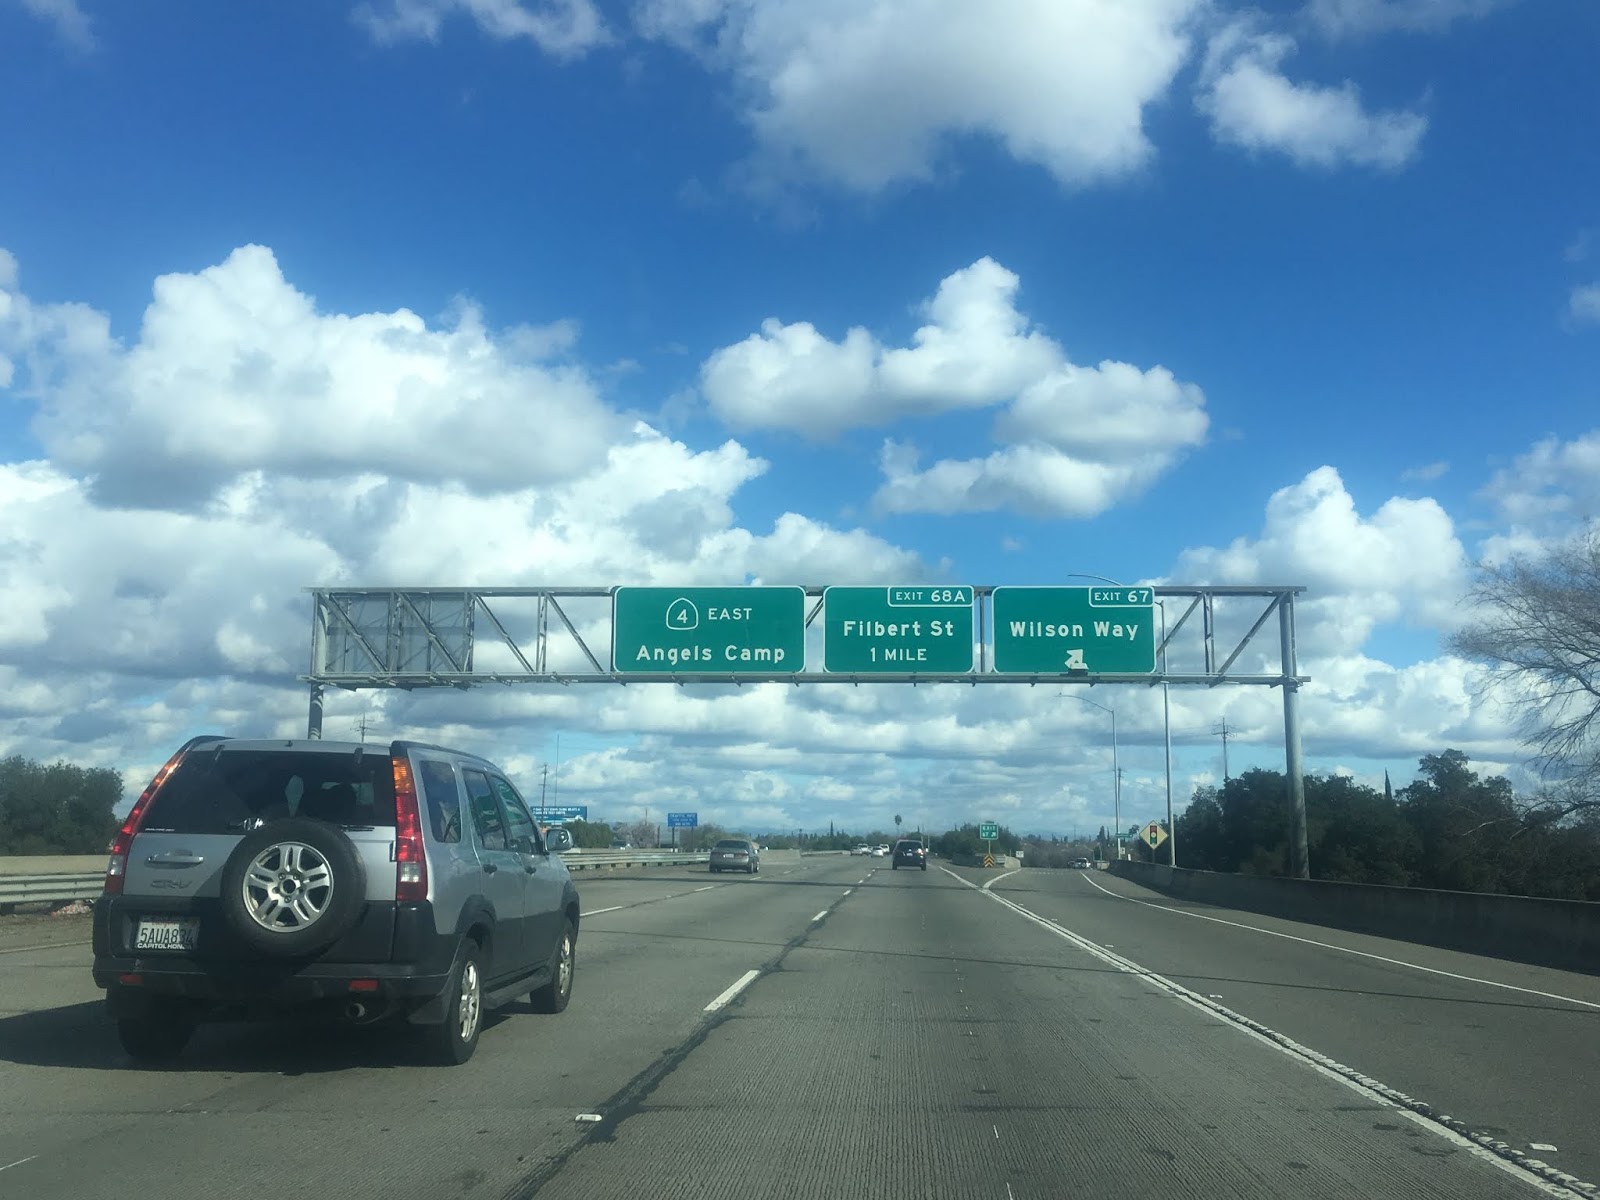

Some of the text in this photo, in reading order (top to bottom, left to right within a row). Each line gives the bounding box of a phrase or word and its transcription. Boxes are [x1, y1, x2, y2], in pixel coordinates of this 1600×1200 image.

[895, 590, 966, 602] EXIT 68A
[1094, 590, 1149, 602] EXIT 67
[676, 607, 752, 624] 4 EAST
[843, 620, 954, 637] Filbert St
[1010, 621, 1138, 641] Wilson Way
[636, 644, 785, 665] Angels Camp
[870, 647, 927, 662] 1 MILE
